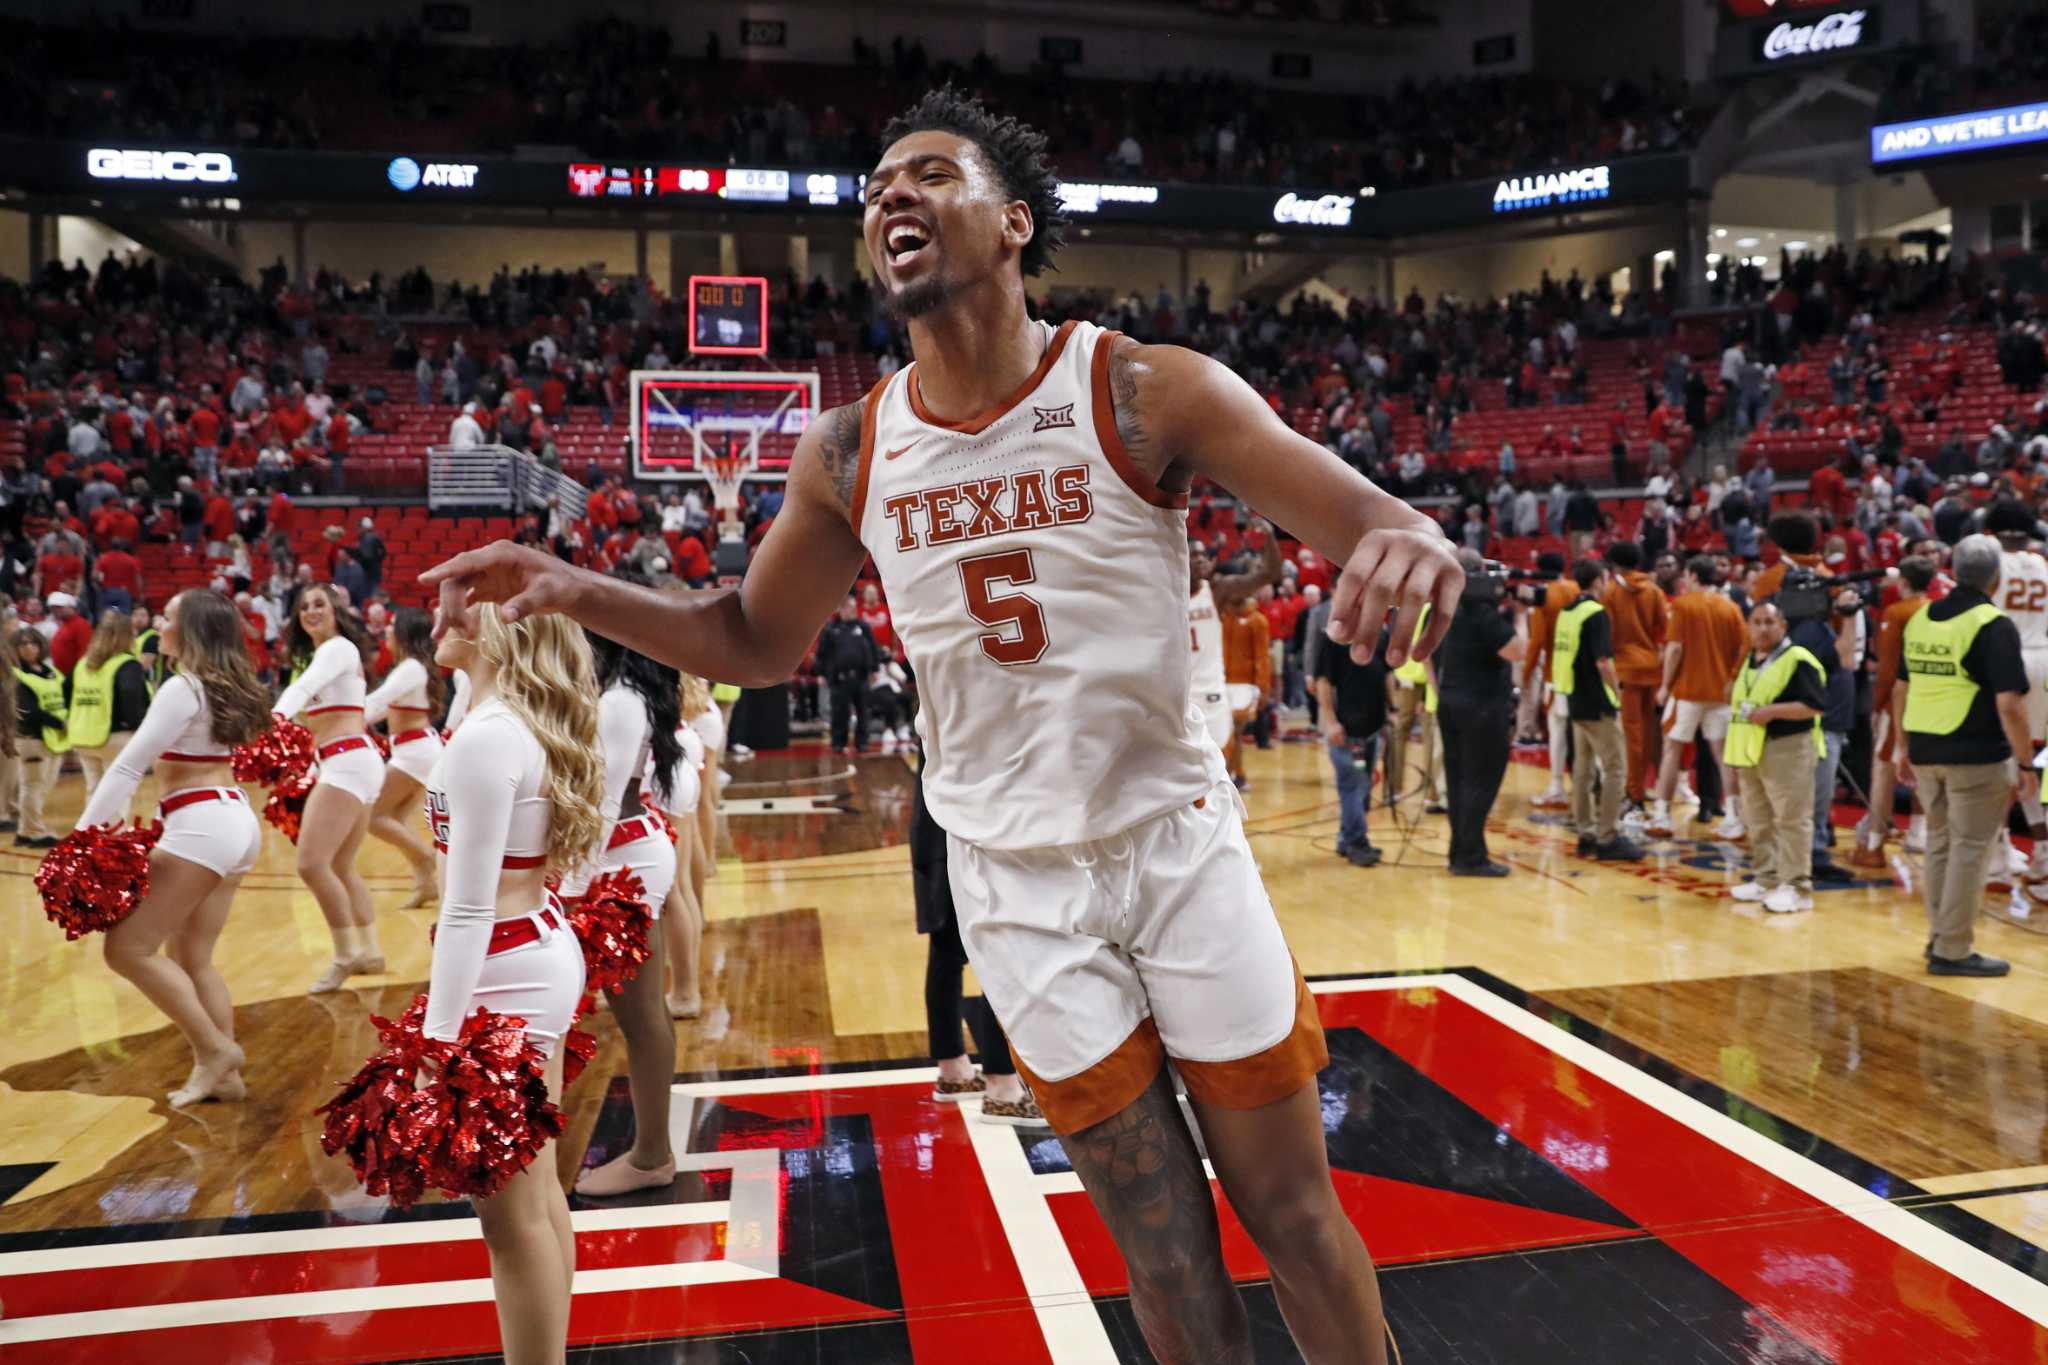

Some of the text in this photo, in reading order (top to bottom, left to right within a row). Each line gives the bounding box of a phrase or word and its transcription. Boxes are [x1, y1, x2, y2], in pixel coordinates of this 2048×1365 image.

[1882, 127, 1931, 152] AND
[87, 149, 232, 182] GEICO
[422, 164, 479, 187] AT&T
[1493, 165, 1609, 203] ALLIANCE
[883, 464, 1094, 552] TEXAS
[957, 547, 1049, 666] 5
[2005, 577, 2047, 613] 22
